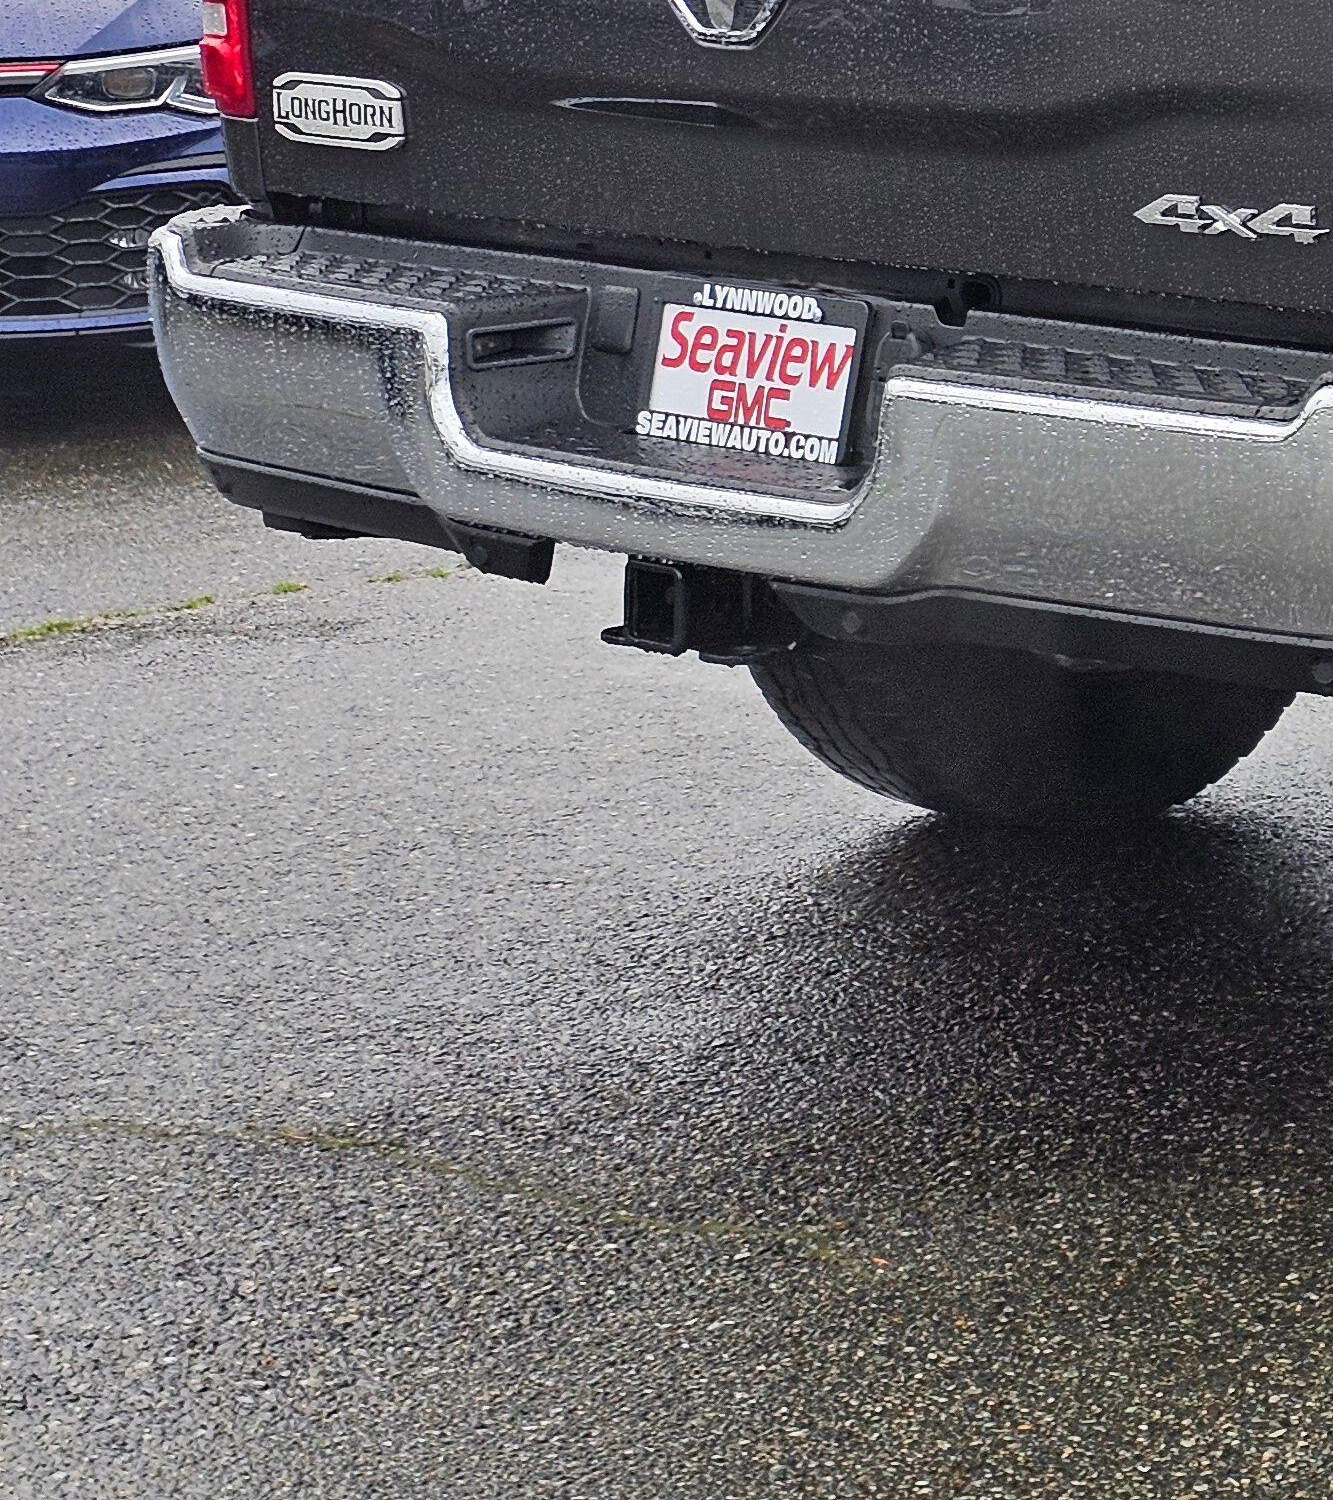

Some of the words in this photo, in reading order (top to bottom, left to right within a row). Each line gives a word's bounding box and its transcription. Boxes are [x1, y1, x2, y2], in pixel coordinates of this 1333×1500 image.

[702, 283, 819, 321] LYNNWOOD
[660, 310, 855, 390] Seaview
[706, 378, 792, 430] GMC
[634, 410, 839, 465] SEAVIEWAUTO.COM
